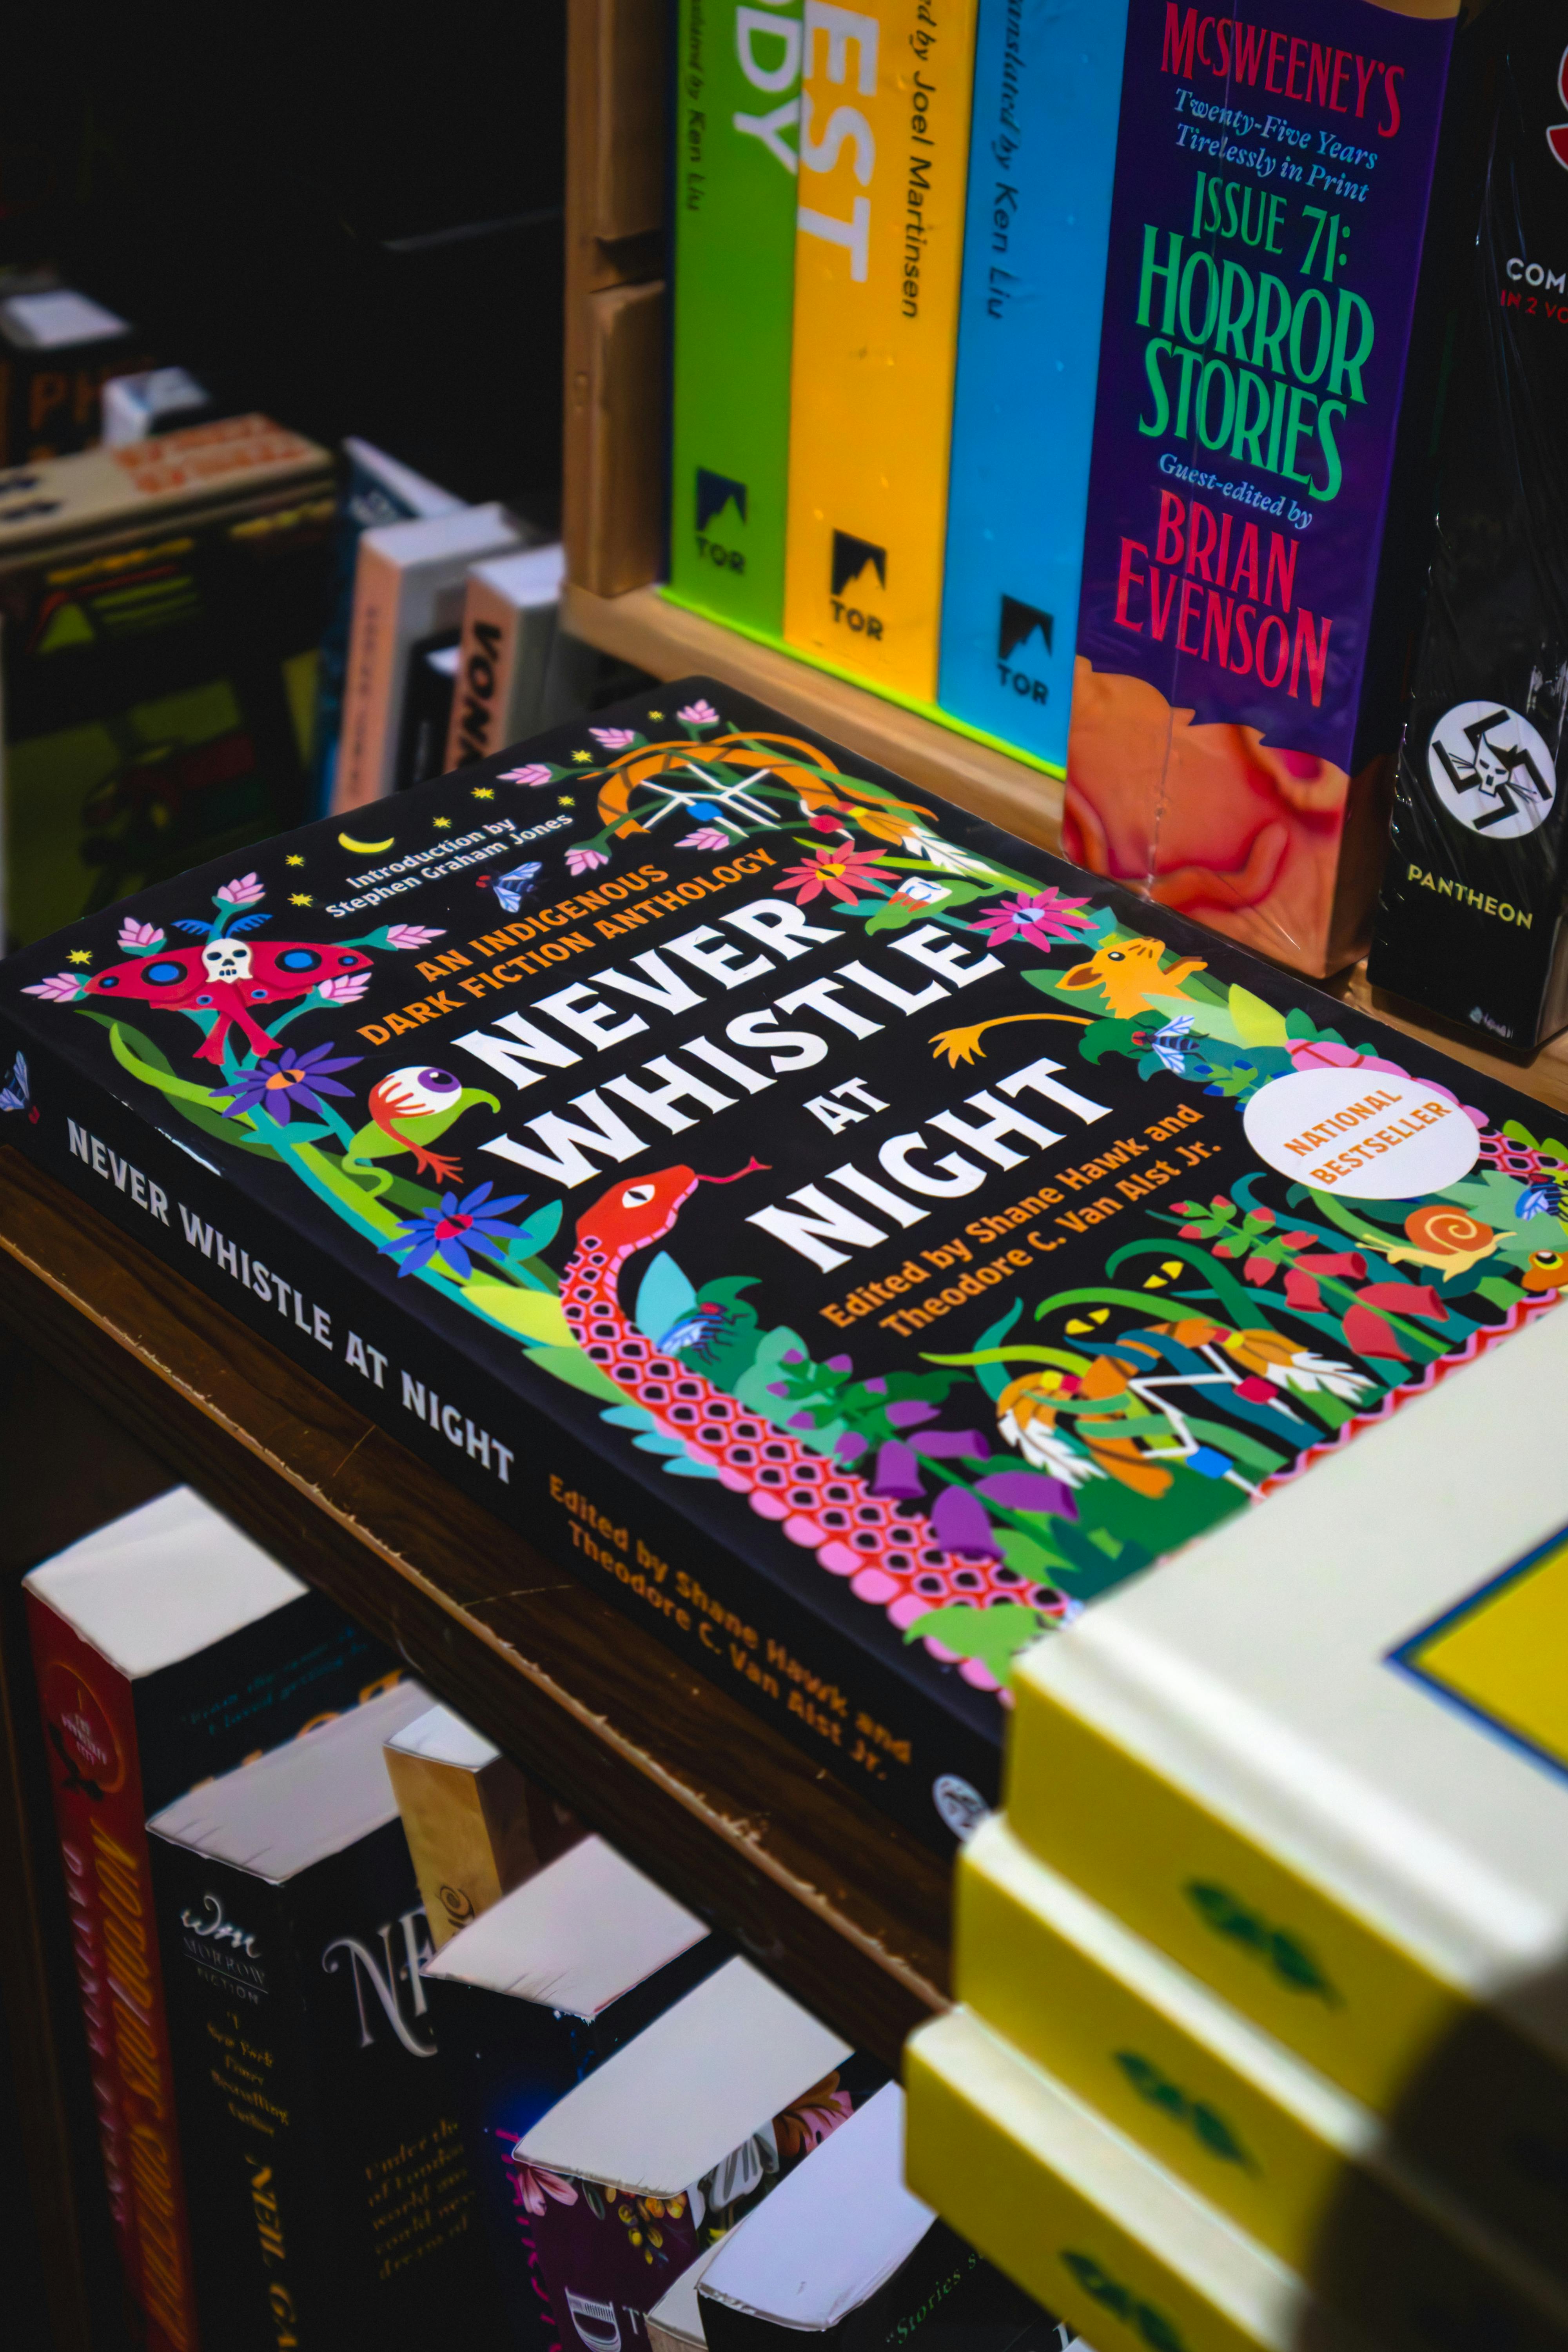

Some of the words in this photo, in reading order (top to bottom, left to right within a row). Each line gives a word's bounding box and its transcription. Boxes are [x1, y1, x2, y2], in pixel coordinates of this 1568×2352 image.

[734, 0, 804, 176] DY
[909, 30, 936, 62] by
[688, 109, 706, 163] Ken
[797, 0, 880, 283] EST
[911, 71, 936, 145] Joel
[1174, 88, 1312, 151] Twenty-Five
[1315, 131, 1378, 170] Years
[686, 173, 706, 212] Liu
[991, 134, 1018, 171] by
[1176, 122, 1277, 178] Tirelessly
[1280, 156, 1304, 182] in
[1306, 164, 1369, 203] Print
[902, 155, 933, 318] Martinsen
[993, 181, 1019, 254] Ken
[1192, 171, 1287, 255] ISSUE
[1299, 204, 1351, 283] 71:
[987, 267, 1014, 319] Liu
[1136, 223, 1375, 404] HORROR
[1500, 289, 1522, 310] IN
[1525, 296, 1538, 315] 2
[1506, 257, 1568, 296] COM
[1138, 337, 1348, 502] STORIES
[1158, 452, 1286, 517] Guest-edited
[1286, 499, 1313, 532] by
[695, 535, 746, 575] TOR
[1155, 488, 1300, 615] BRIAN
[829, 599, 884, 642] TOR
[1113, 535, 1334, 708] EVENSON
[996, 663, 1049, 706] TOR
[325, 876, 424, 918] Stephen
[420, 840, 510, 880] Graham
[509, 813, 574, 846] Jones
[345, 830, 486, 889] Introduction
[482, 818, 517, 836] by
[414, 949, 474, 983] AN
[467, 864, 669, 958] INDIGENOUS
[1407, 864, 1534, 931] PANTHEON
[356, 989, 468, 1046] DARK
[457, 932, 595, 999] FICTION
[592, 847, 778, 941] ANTHOLOGY
[450, 898, 846, 1091] NEVER
[477, 924, 1005, 1189] WHISTLE
[802, 1077, 891, 1135] AT
[1284, 1089, 1404, 1157] NATIONAL
[1310, 1100, 1453, 1185] BESTSELLER
[744, 1057, 1113, 1274] NIGHT
[818, 1259, 932, 1329] Edited
[919, 1238, 974, 1270] by
[964, 1187, 1065, 1244] Shane
[1054, 1137, 1150, 1191] Hawk
[1143, 1103, 1206, 1142] and
[878, 1248, 1034, 1338] Theodore
[1026, 1230, 1067, 1252] C.
[1053, 1196, 1125, 1234] Van
[1114, 1159, 1182, 1202] Alst
[1174, 1140, 1222, 1167] Jr.
[67, 1117, 171, 1227] NEVER
[178, 1201, 334, 1351] WHISTLE
[345, 1329, 388, 1389] AT
[401, 1370, 515, 1485] NIGHT
[550, 1473, 628, 1552] Edited
[637, 1540, 668, 1584] by
[676, 1571, 759, 1649] Shane
[767, 1638, 849, 1718] Hawk
[855, 1712, 912, 1765] and
[568, 1520, 692, 1632] Theodore
[699, 1621, 722, 1655] C.
[730, 1643, 780, 1700] Van
[787, 1690, 843, 1747] Alst
[849, 1737, 887, 1781] Jr.
